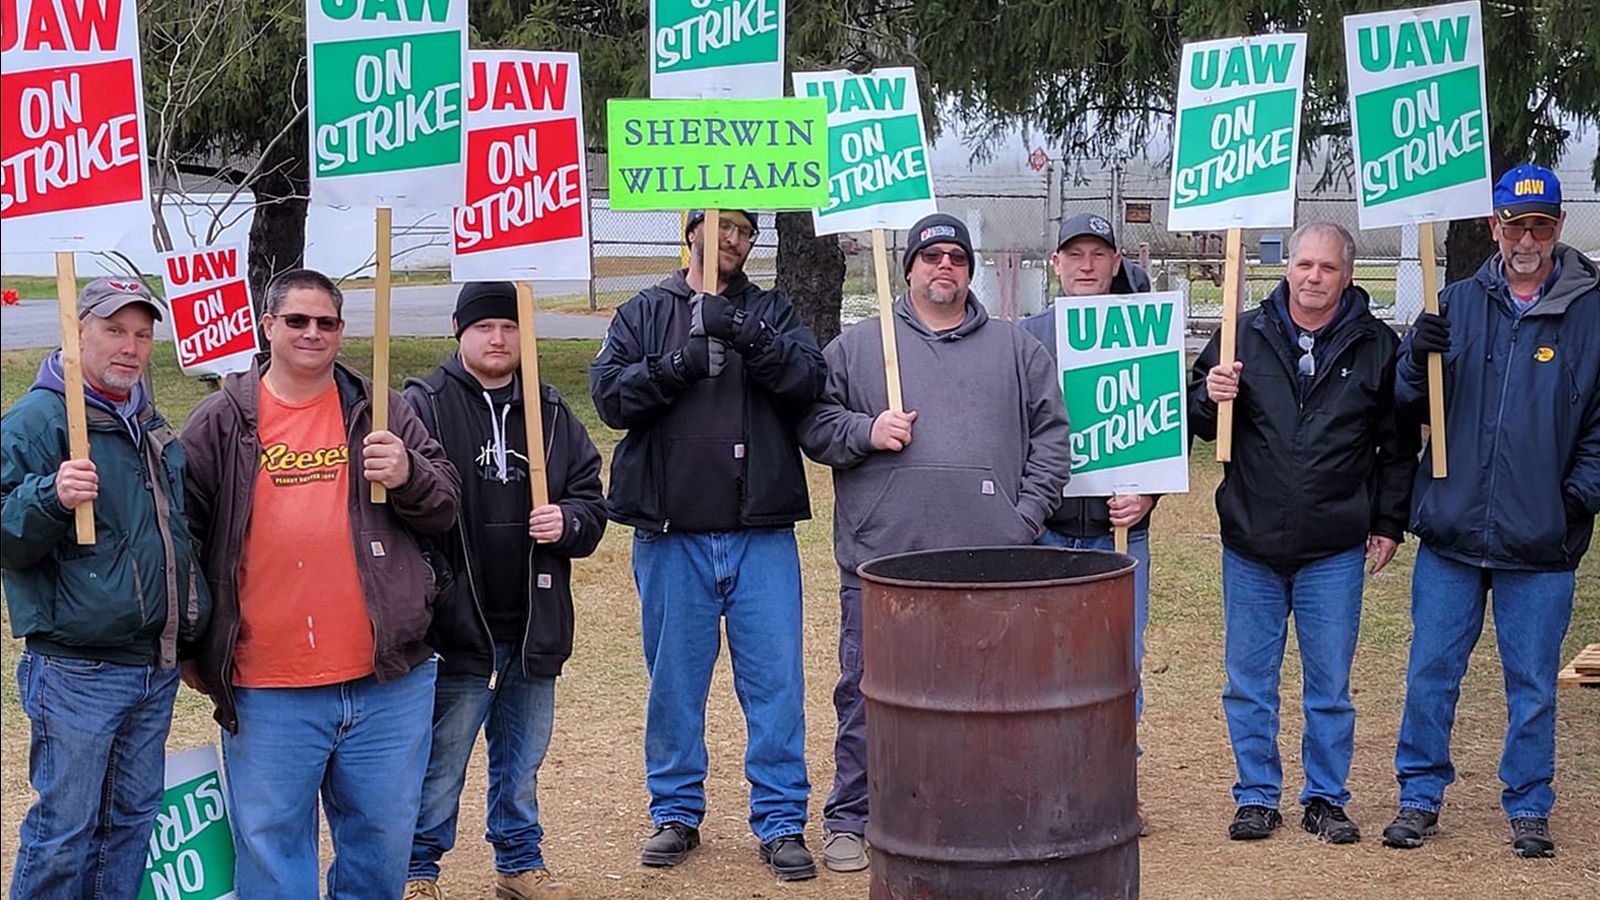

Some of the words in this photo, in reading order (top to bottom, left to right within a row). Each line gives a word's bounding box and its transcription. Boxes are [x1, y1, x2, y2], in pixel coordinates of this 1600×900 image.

[657, 0, 778, 68] STRIKE
[1358, 15, 1470, 72] UAW
[355, 42, 411, 103] ON
[1191, 43, 1295, 90] UAW
[20, 72, 83, 139] ON
[806, 77, 906, 114] UAW
[1393, 82, 1440, 138] ON
[317, 82, 460, 172] STRIKE
[625, 118, 814, 146] SHERWIN
[841, 122, 885, 163] ON
[1211, 100, 1256, 150] ON
[488, 128, 537, 185] ON
[619, 161, 820, 194] WILLIAMS
[1177, 127, 1293, 204] STRIKE
[1363, 109, 1482, 201] STRIKE
[455, 164, 579, 249] STRIKE
[1514, 179, 1545, 195] UAW
[166, 249, 237, 285] UAW
[193, 289, 225, 325] ON
[1068, 303, 1173, 351] UAW
[180, 306, 252, 364] STRIKE
[1096, 363, 1140, 413] ON
[1069, 392, 1180, 469] STRIKE
[151, 849, 204, 900] ON
